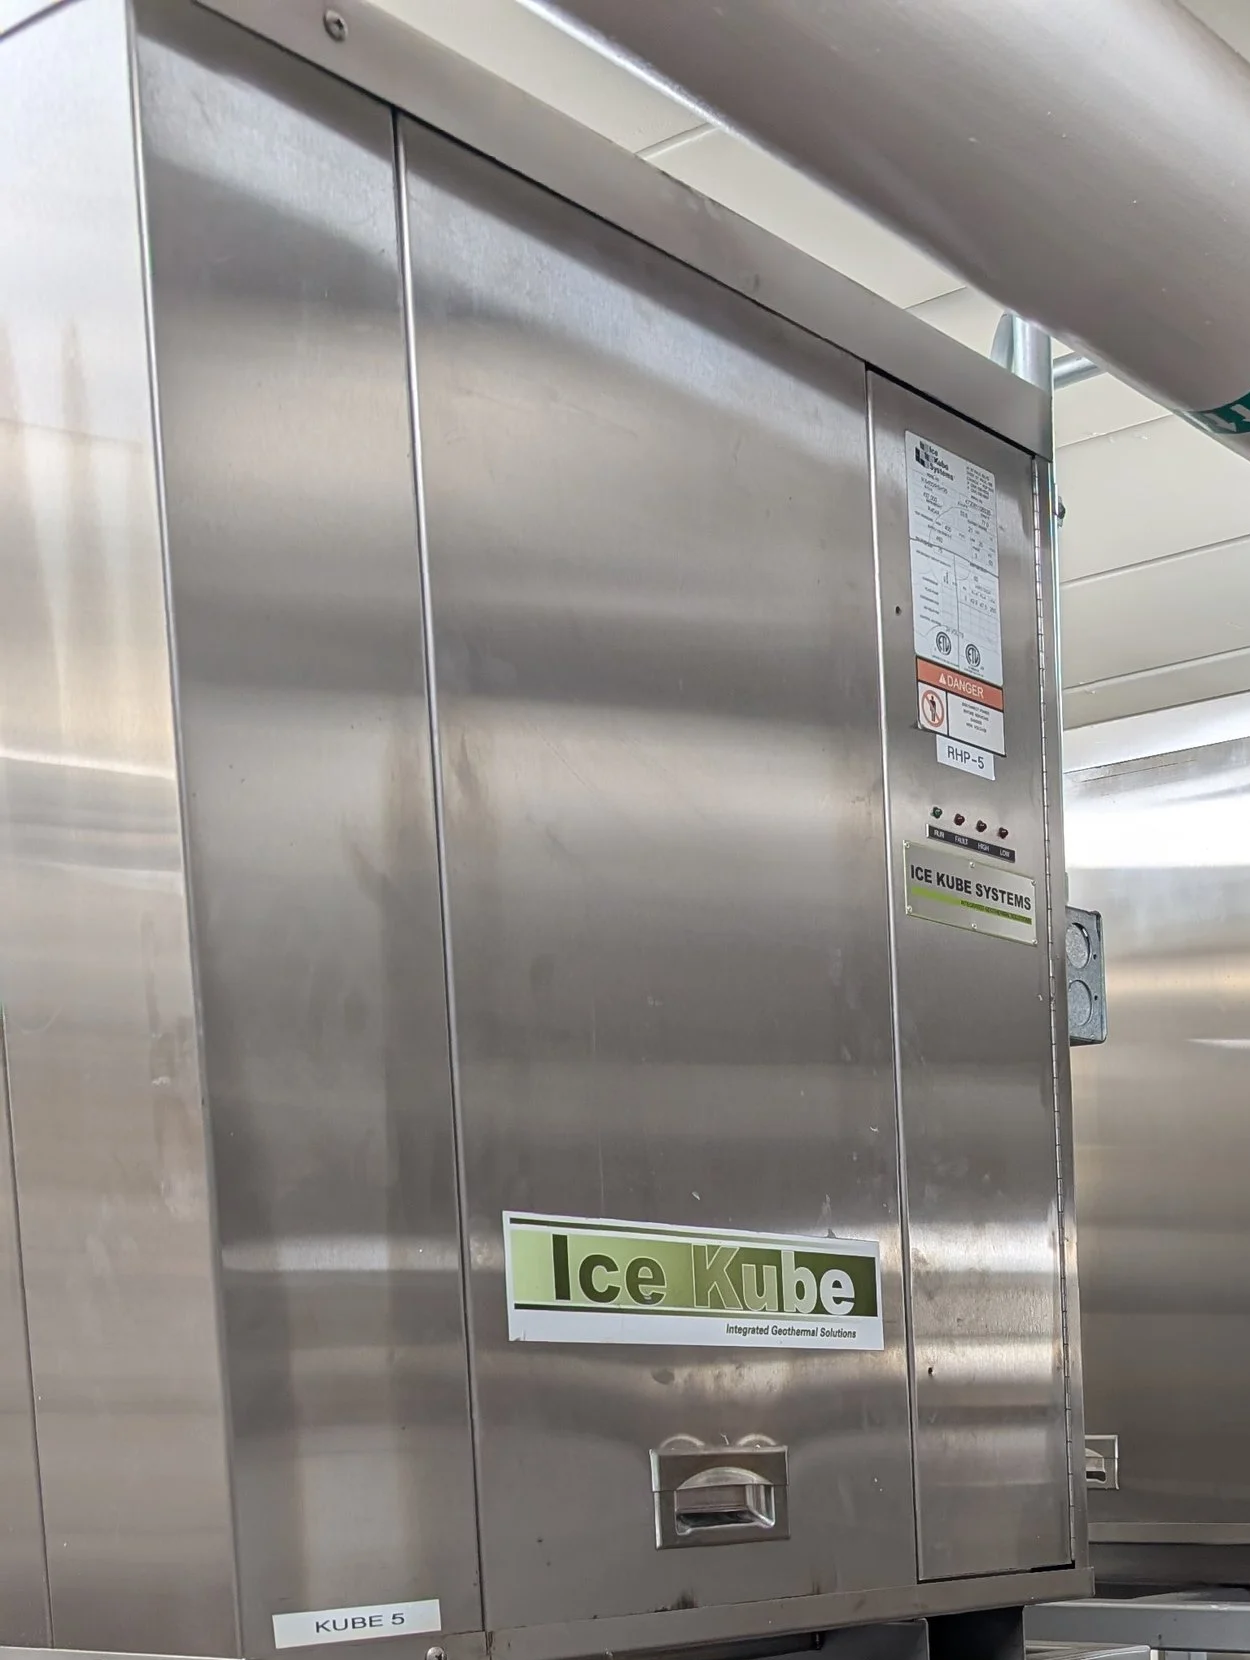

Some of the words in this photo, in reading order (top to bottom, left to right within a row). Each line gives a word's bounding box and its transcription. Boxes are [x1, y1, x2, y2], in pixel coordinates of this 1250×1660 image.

[947, 676, 984, 699] DANGER
[947, 745, 985, 769] RHP-5
[933, 829, 945, 839] RUN
[955, 836, 969, 845] FAULT
[977, 843, 990, 852] HIGH
[1000, 849, 1010, 857] LOW
[910, 864, 932, 884] ICE
[936, 871, 972, 895] KUBE
[975, 883, 1032, 911] SYSTEMS
[551, 1233, 668, 1307] Ice
[691, 1243, 856, 1316] Kube
[726, 1323, 770, 1337] Integrated
[771, 1325, 819, 1337] Geothermal
[819, 1327, 857, 1339] Solutions
[315, 1614, 383, 1634] KUBE
[391, 1612, 406, 1626] 5
